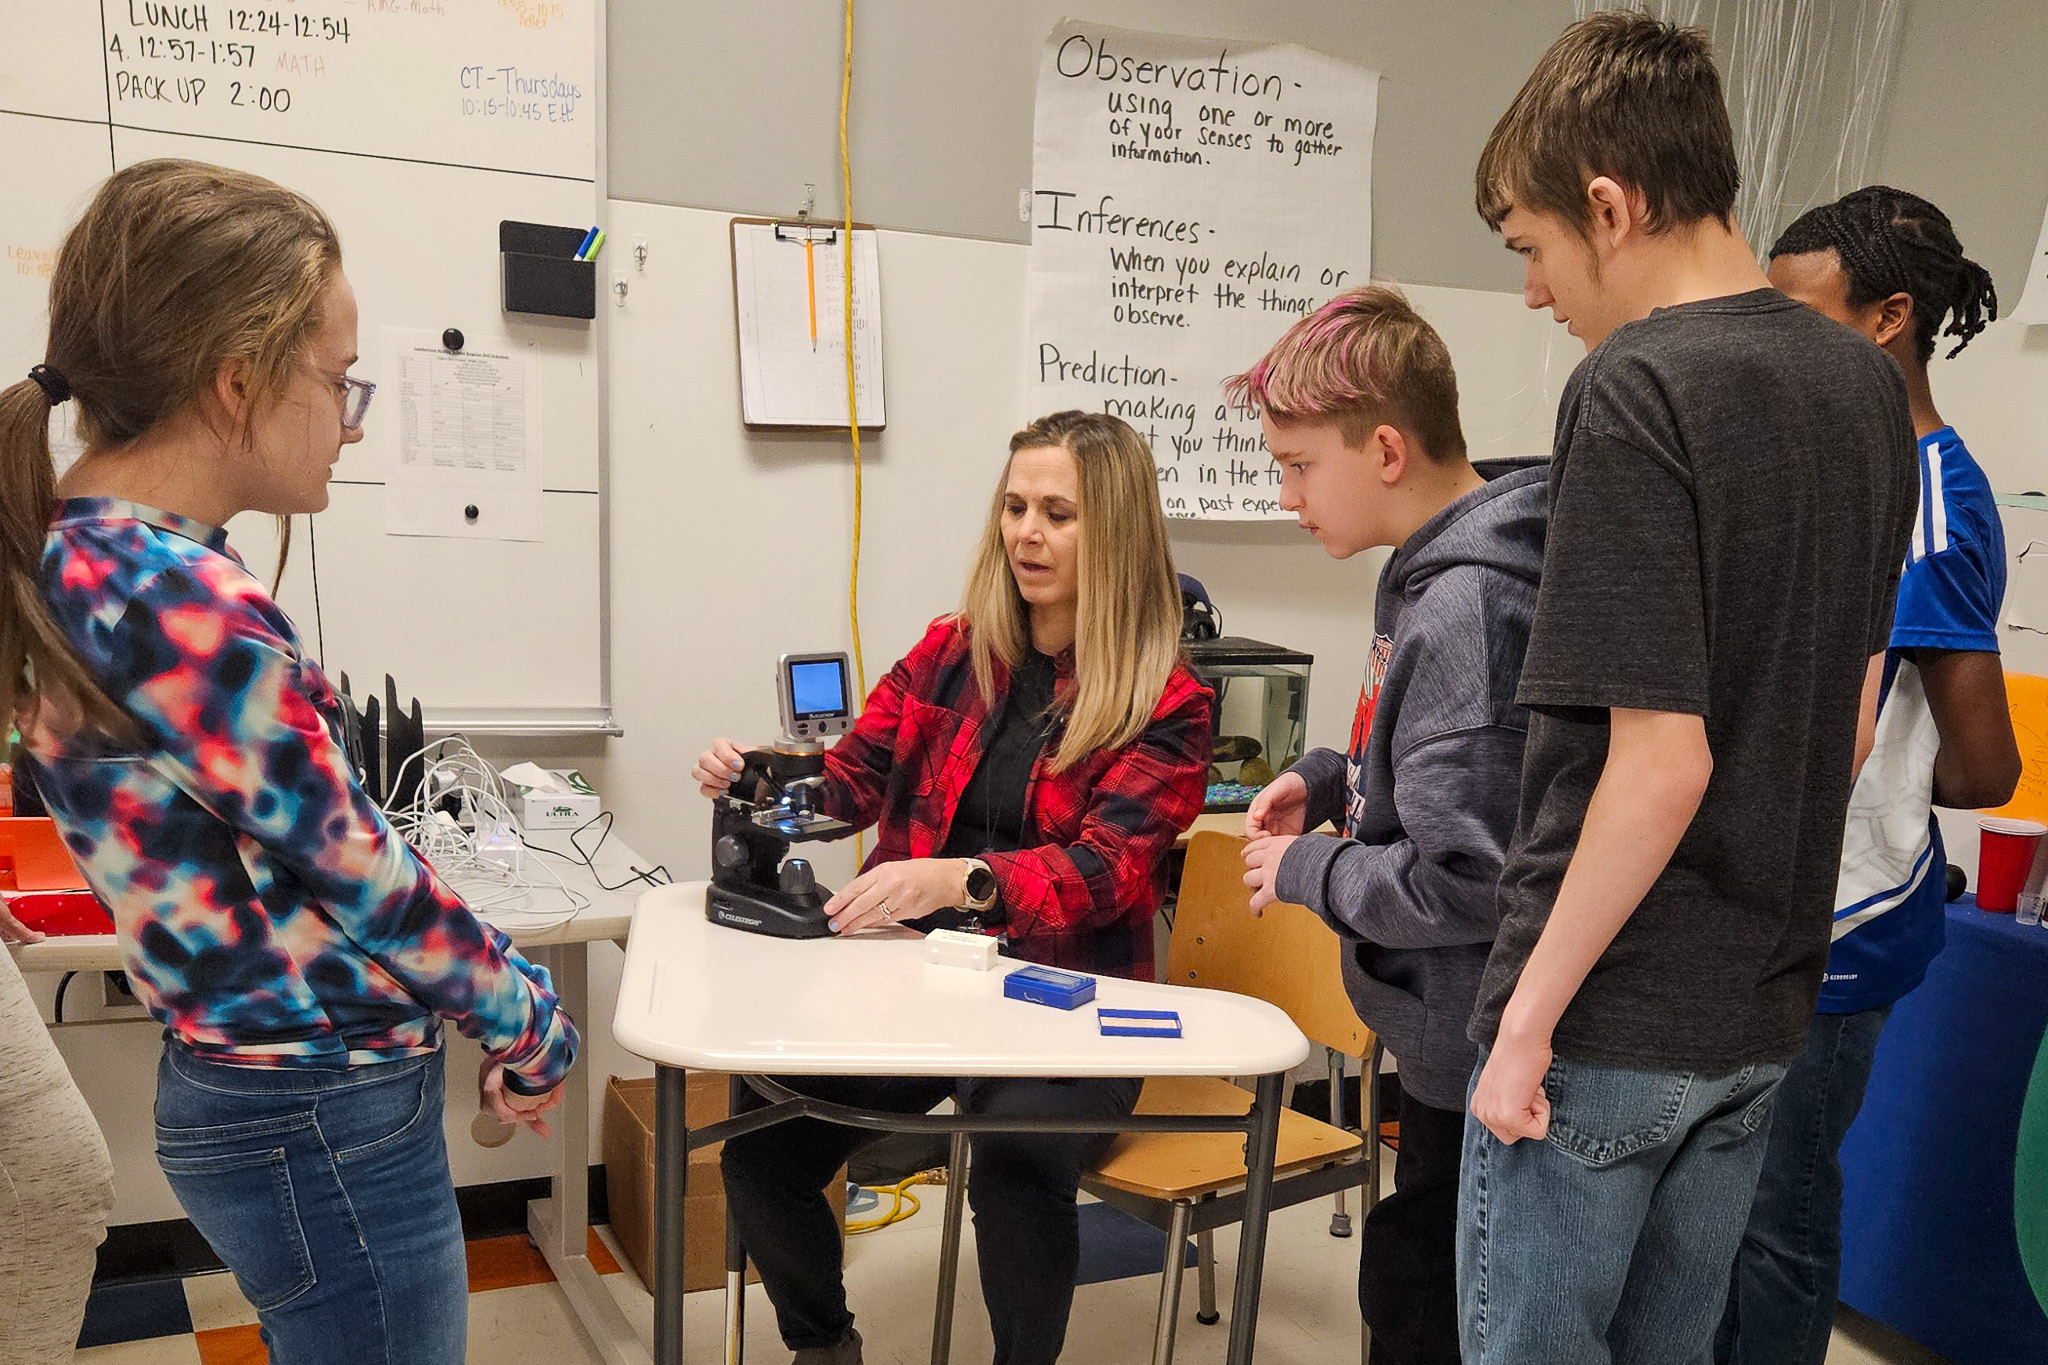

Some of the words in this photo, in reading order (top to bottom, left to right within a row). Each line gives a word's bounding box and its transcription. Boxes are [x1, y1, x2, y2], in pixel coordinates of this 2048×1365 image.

[128, 0, 208, 32] LUNCH
[275, 52, 326, 78] MATH
[116, 71, 172, 103] PACK
[177, 78, 206, 106] UP
[230, 82, 291, 112] 2:00
[1199, 105, 1236, 126] one
[1254, 111, 1274, 126] or
[1285, 118, 1334, 139] more
[1140, 123, 1182, 147] your
[1197, 127, 1252, 150] senses
[1267, 135, 1284, 154] to
[1294, 139, 1343, 166] gather
[1110, 247, 1165, 272] When
[1176, 256, 1210, 285] you
[1224, 251, 1301, 284] explain
[1320, 268, 1350, 287] or
[1112, 277, 1199, 304] interpret
[1214, 284, 1246, 309] the
[1257, 287, 1315, 317] things
[1104, 396, 1196, 435] making
[1215, 405, 1227, 421] a
[1171, 435, 1203, 461] you
[1212, 427, 1270, 452] think
[1199, 464, 1217, 484] in
[1225, 459, 1259, 486] the
[1166, 497, 1186, 509] on
[1199, 494, 1234, 514] past
[1242, 497, 1283, 515] expe
[725, 913, 763, 926] CELESTRON
